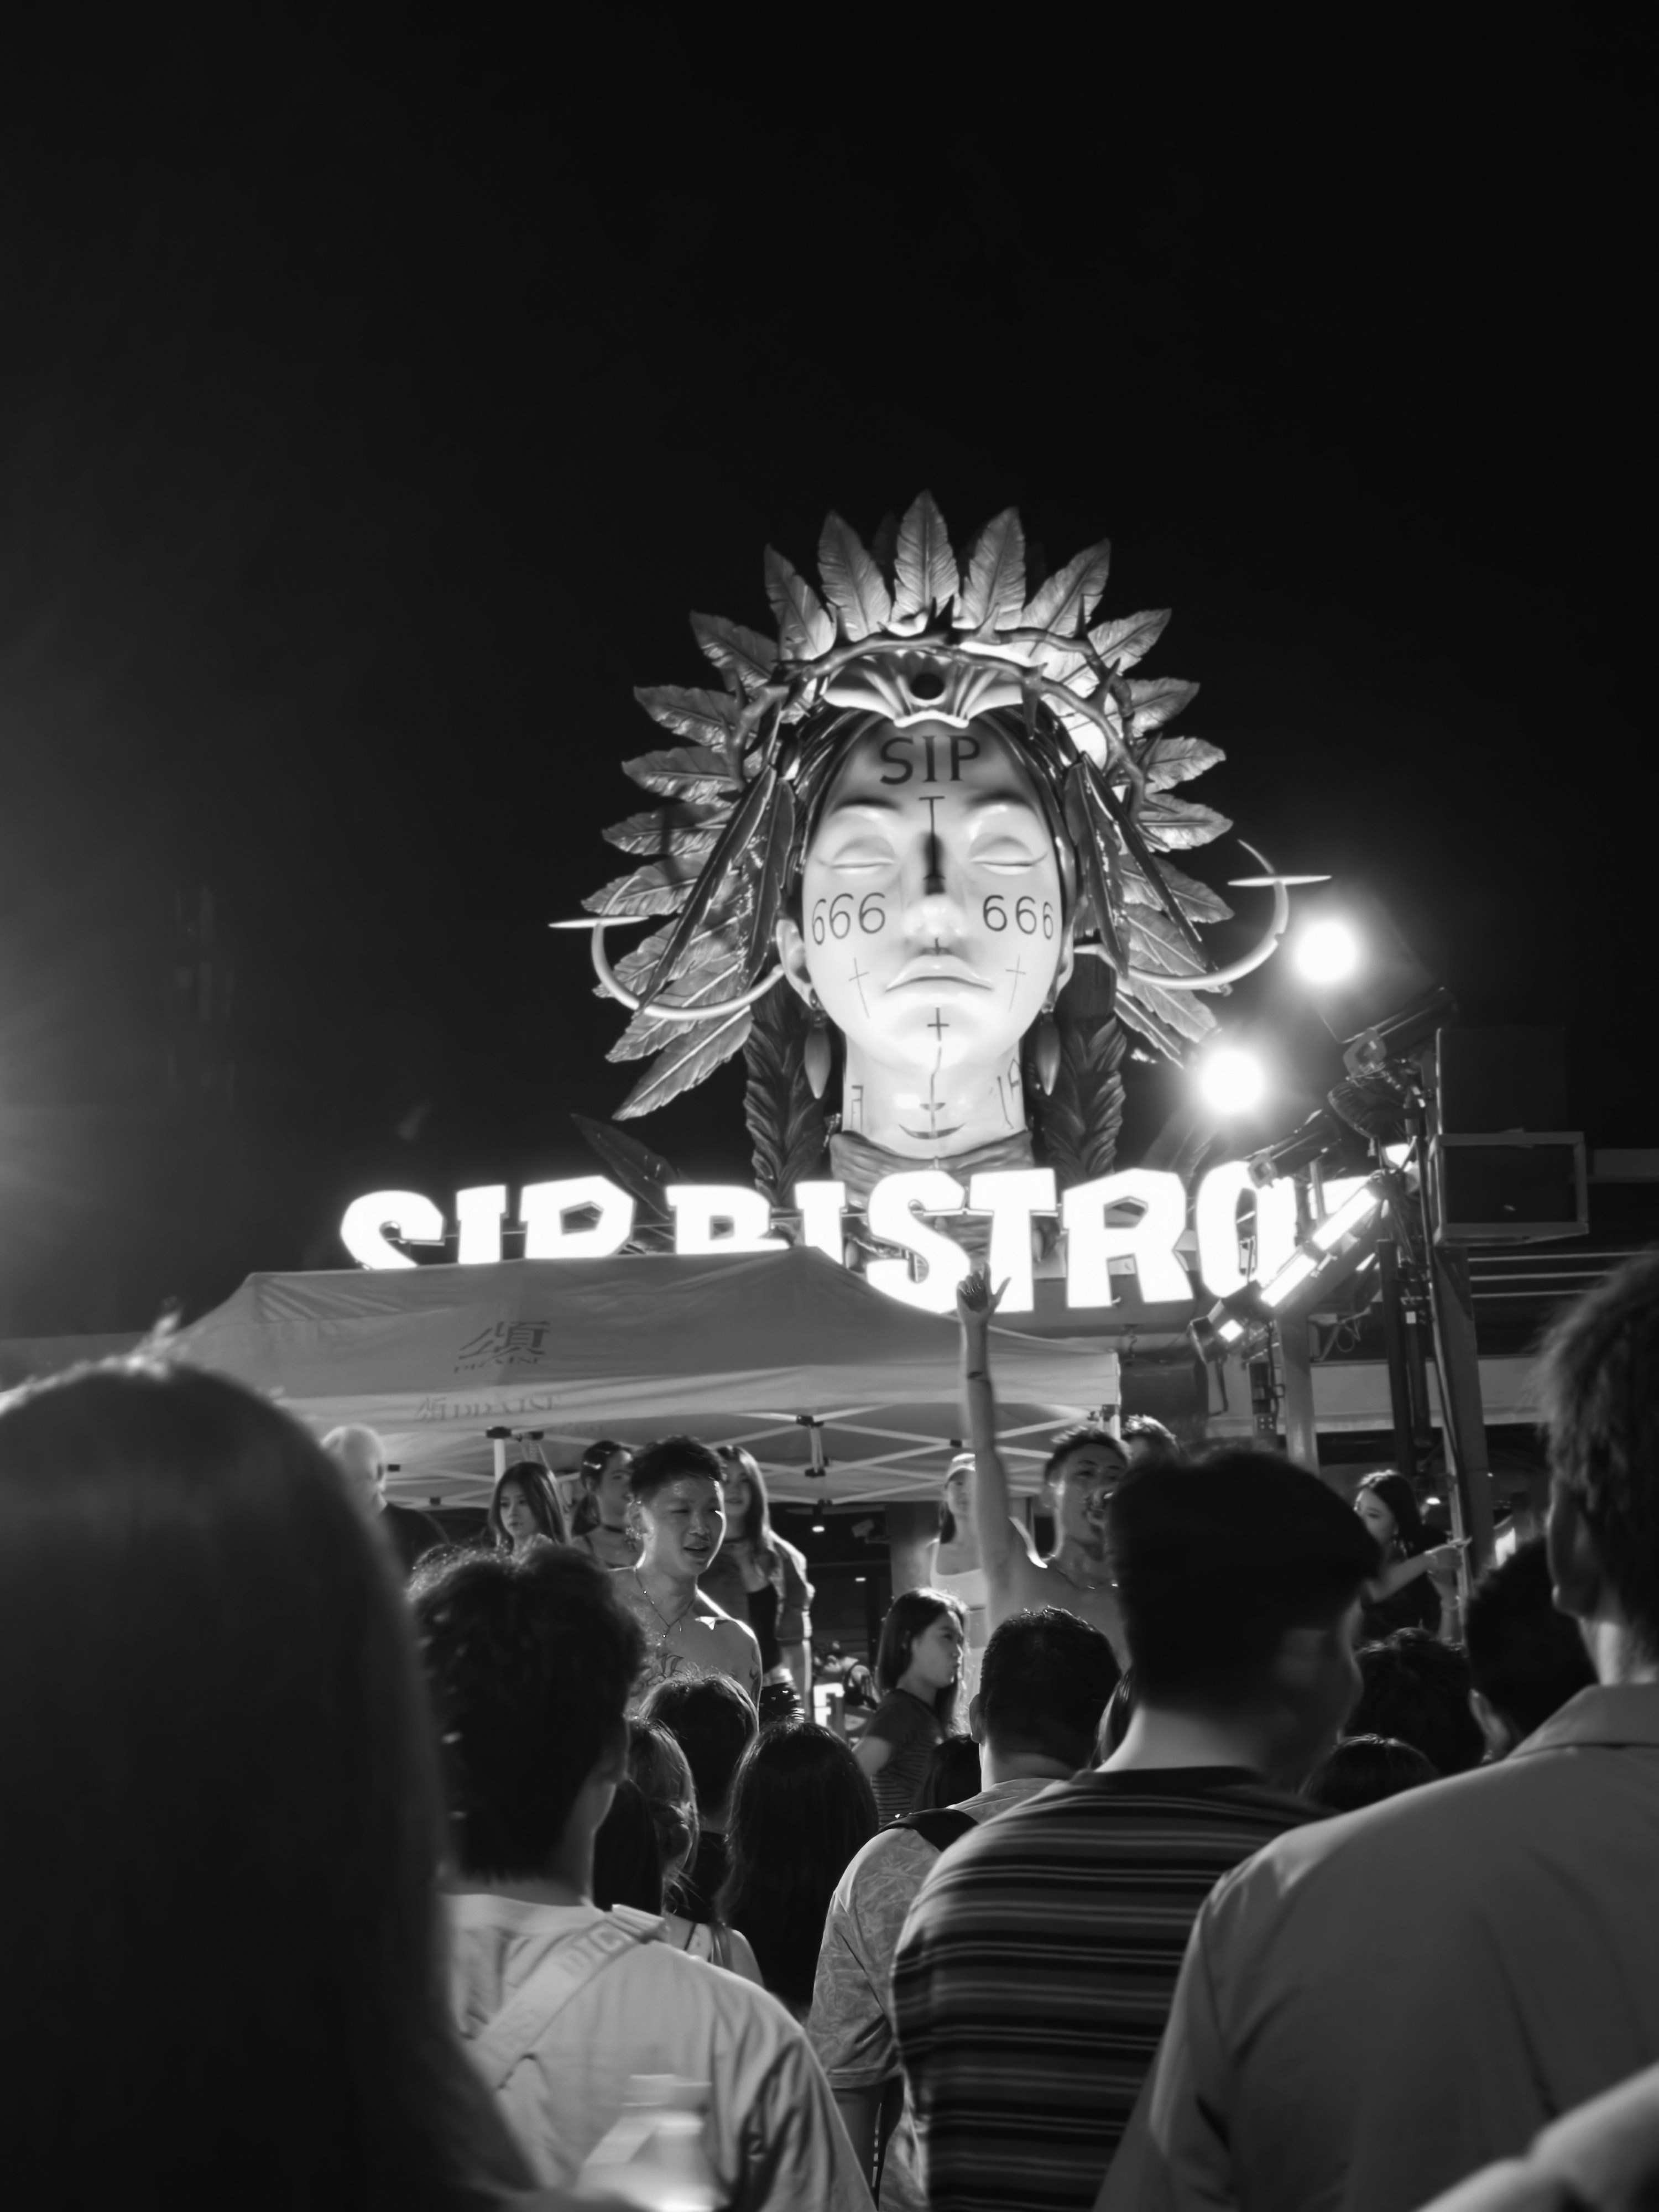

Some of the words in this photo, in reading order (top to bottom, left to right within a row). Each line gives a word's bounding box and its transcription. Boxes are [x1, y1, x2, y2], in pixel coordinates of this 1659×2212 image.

[880, 735, 980, 785] SIP
[812, 893, 885, 945] 666
[983, 895, 1053, 940] 666
